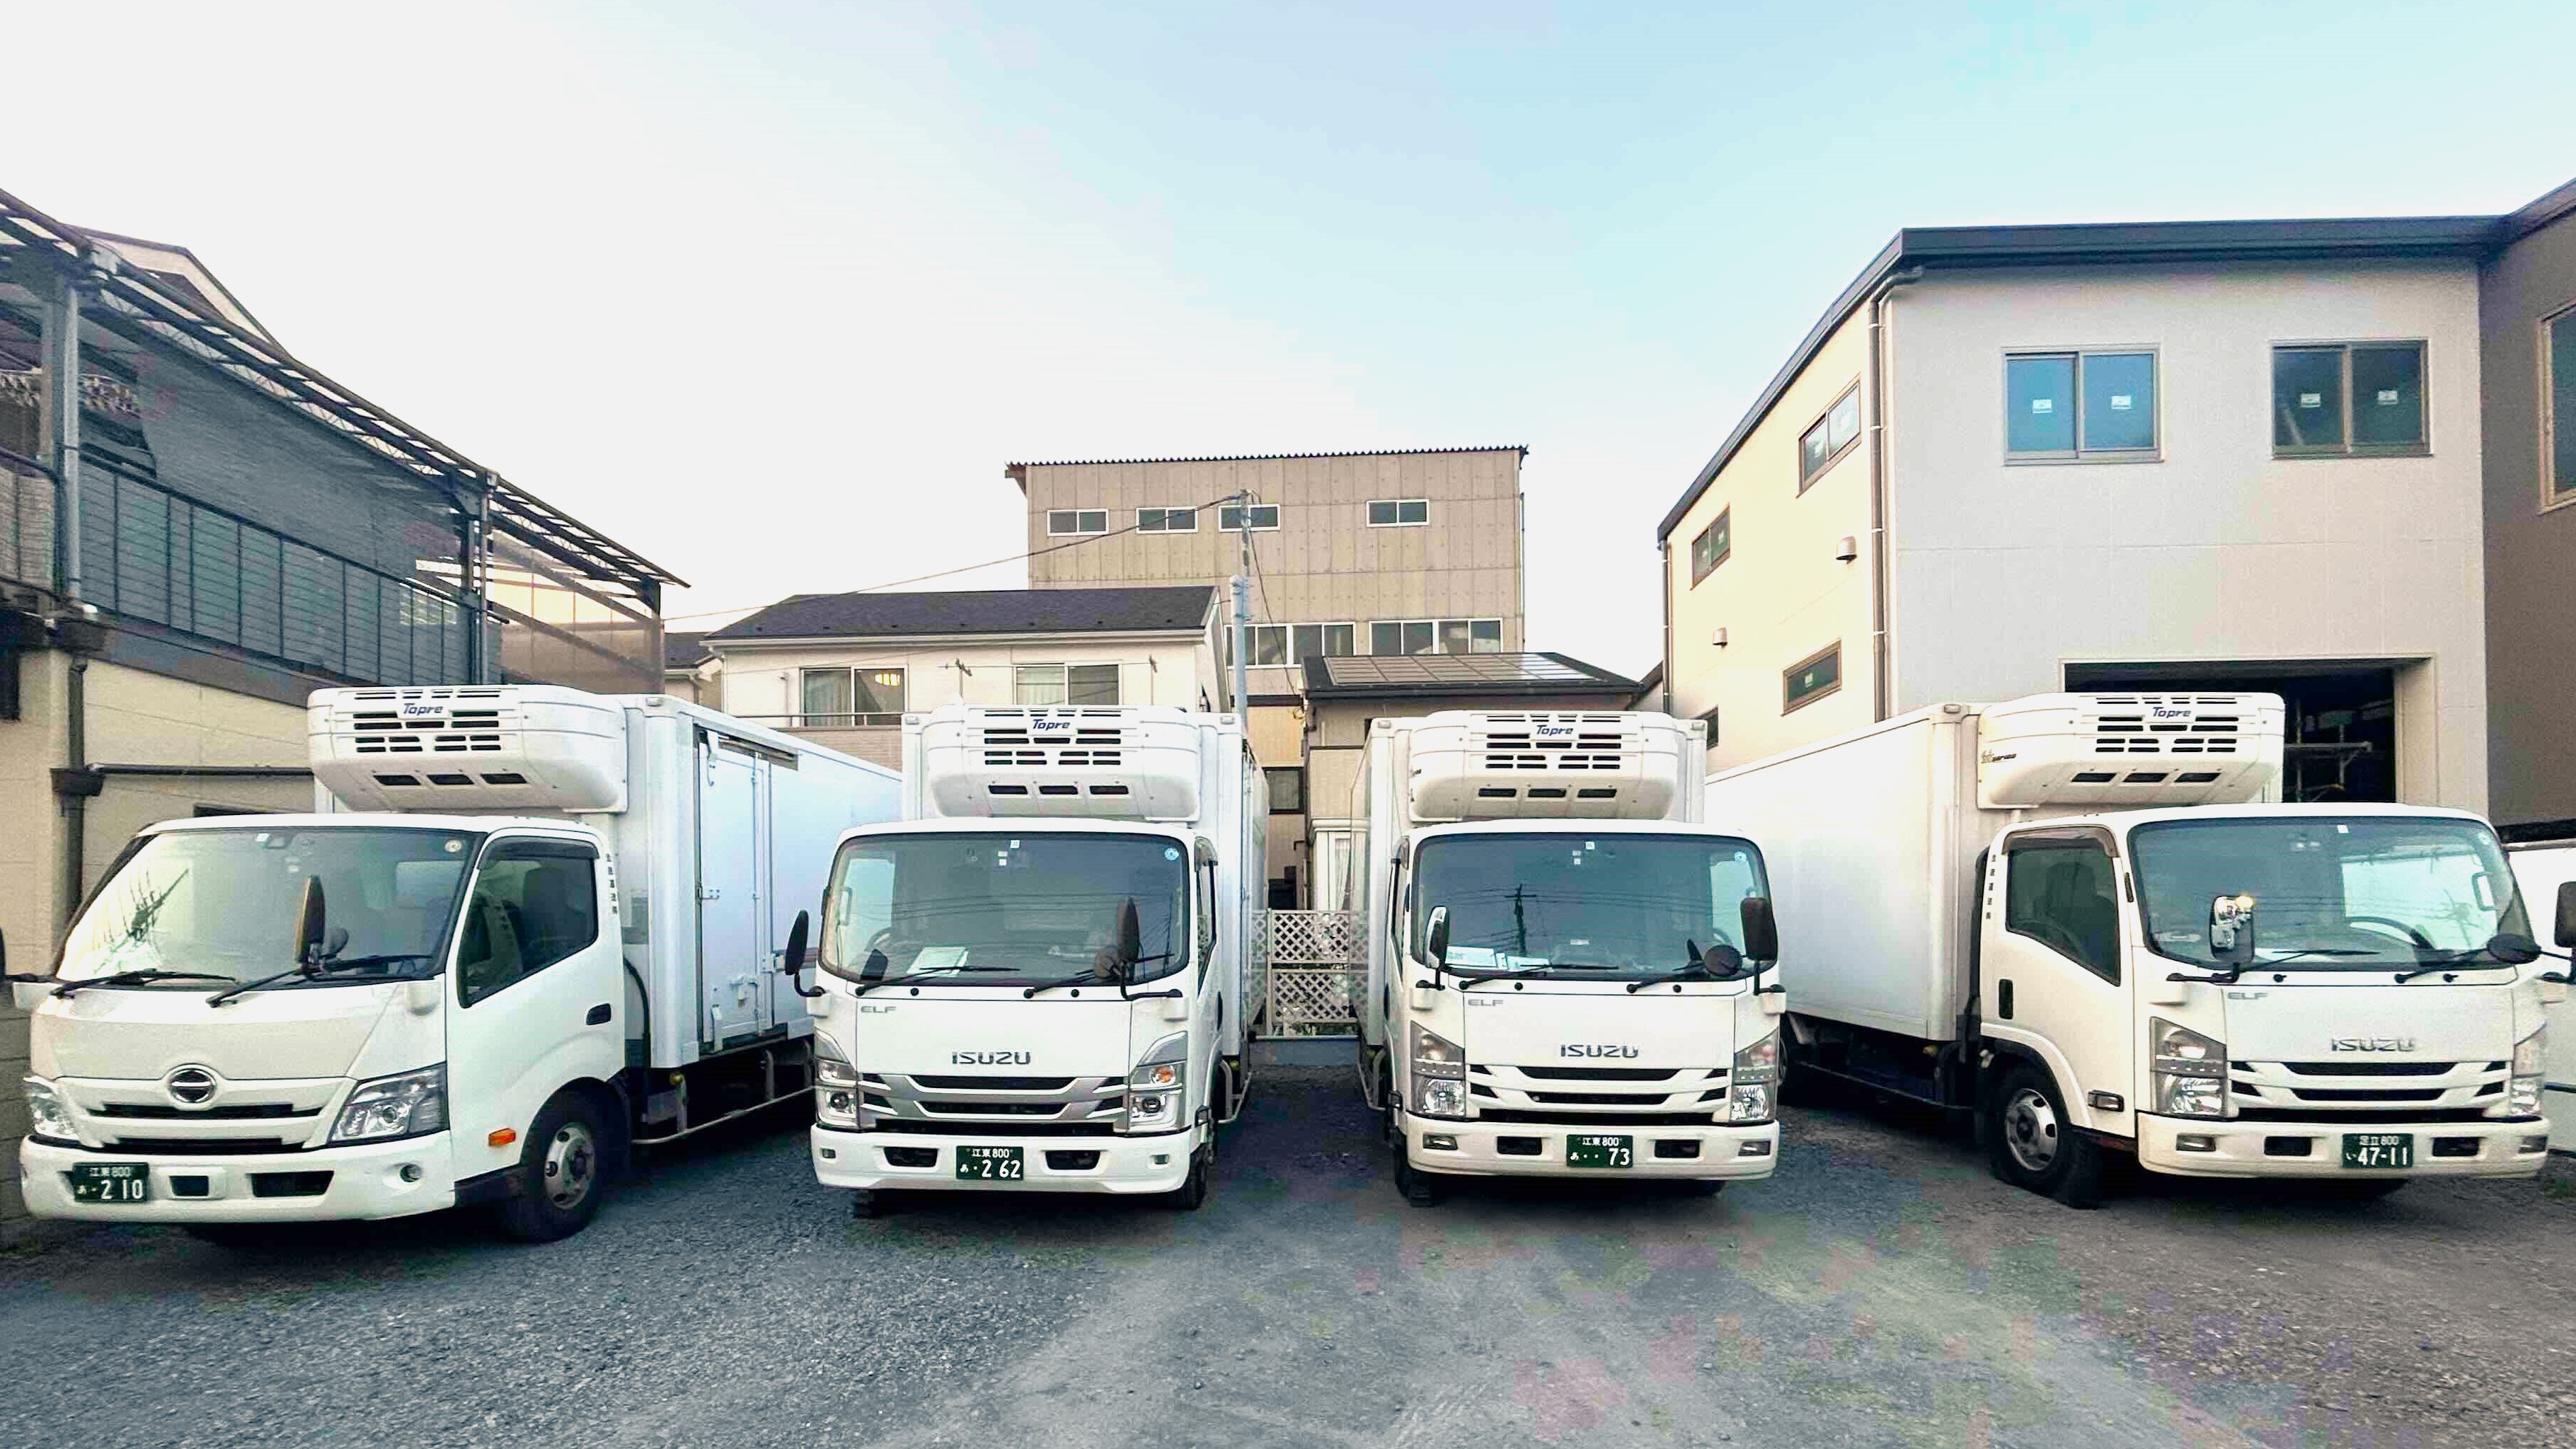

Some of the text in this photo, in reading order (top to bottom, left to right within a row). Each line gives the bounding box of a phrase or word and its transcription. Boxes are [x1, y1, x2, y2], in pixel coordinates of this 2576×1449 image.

[403, 703, 444, 716] Topre
[2152, 706, 2192, 719] Topre
[1033, 719, 1070, 731] Topre
[1536, 724, 1574, 737] Topre
[1560, 1044, 1639, 1058] ISUZU
[2332, 1039, 2415, 1052] ISUZU
[952, 1051, 1031, 1065] ISUZU
[2357, 1147, 2408, 1165] 47-11
